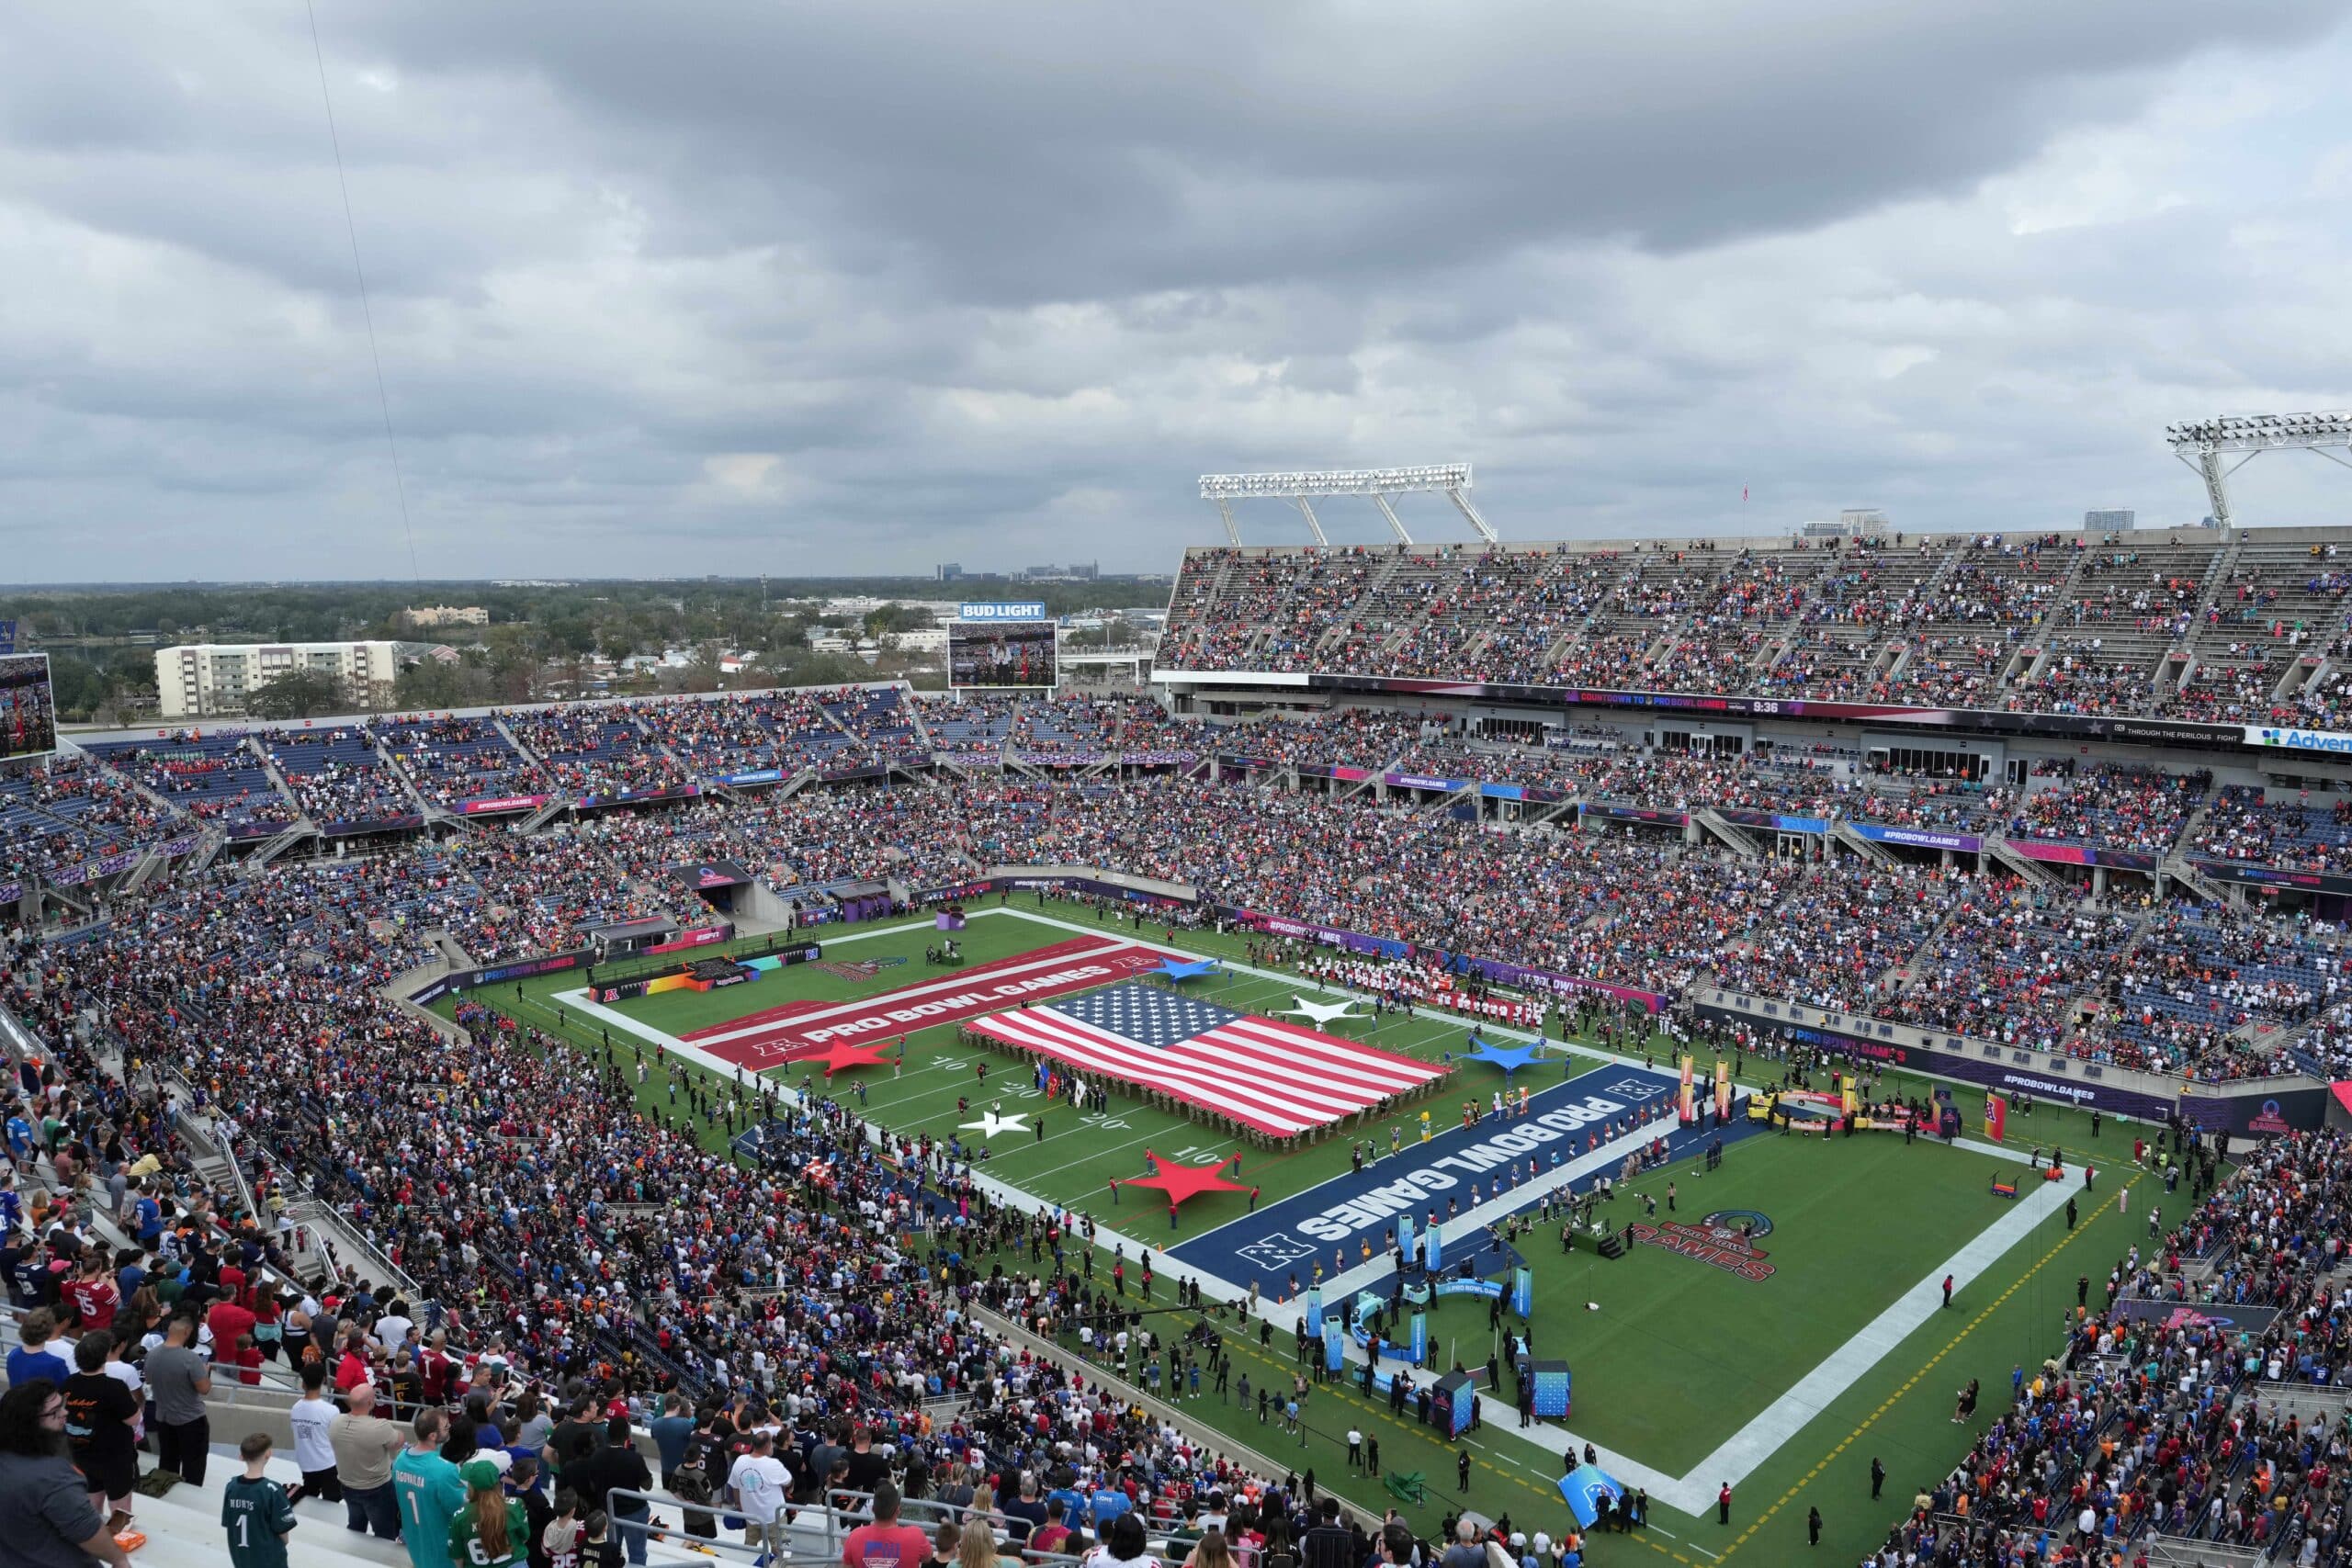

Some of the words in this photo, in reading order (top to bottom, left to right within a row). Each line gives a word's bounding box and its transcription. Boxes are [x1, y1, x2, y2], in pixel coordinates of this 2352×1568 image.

[963, 604, 995, 617] BUD
[997, 604, 1042, 616] LIGHT
[1580, 693, 1632, 705] COUNTDOWN
[1634, 695, 1645, 705] TO
[1654, 696, 1670, 706] PRO
[1671, 697, 1696, 708] BOWL
[1697, 700, 1726, 710] GAMES
[1753, 702, 1778, 713] 9:36
[2128, 728, 2160, 737] THROUGH
[2163, 730, 2176, 739] THE
[2177, 731, 2211, 740] PERILOUS
[2217, 734, 2238, 742] FIGHT
[1883, 830, 1961, 846] #PROBOWLGAMES
[2245, 869, 2264, 878] PRO
[2264, 872, 2290, 881] BOWL
[696, 931, 720, 942] ESPN
[484, 970, 506, 981] PRO
[508, 964, 539, 977] BOWL
[539, 956, 575, 971] GAMES
[801, 1016, 891, 1043] PRO
[883, 990, 1003, 1023] BOWL
[993, 965, 1113, 995] GAMES
[1796, 1029, 1822, 1044] PRO
[1823, 1034, 1857, 1050] BOWL
[930, 1056, 967, 1070] 10
[1000, 1081, 1044, 1099] 20
[1536, 1096, 1627, 1132] PRO
[1171, 1146, 1217, 1165] 10
[1431, 1122, 1566, 1173] BOWL
[1296, 1168, 1459, 1241] GAMES
[1669, 1224, 1705, 1239] PRO
[1618, 1223, 1776, 1282] GAMES
[230, 1498, 254, 1511] HURTS
[407, 1491, 420, 1525] 1
[1096, 1495, 1113, 1504] LIONS
[235, 1514, 250, 1548] 1
